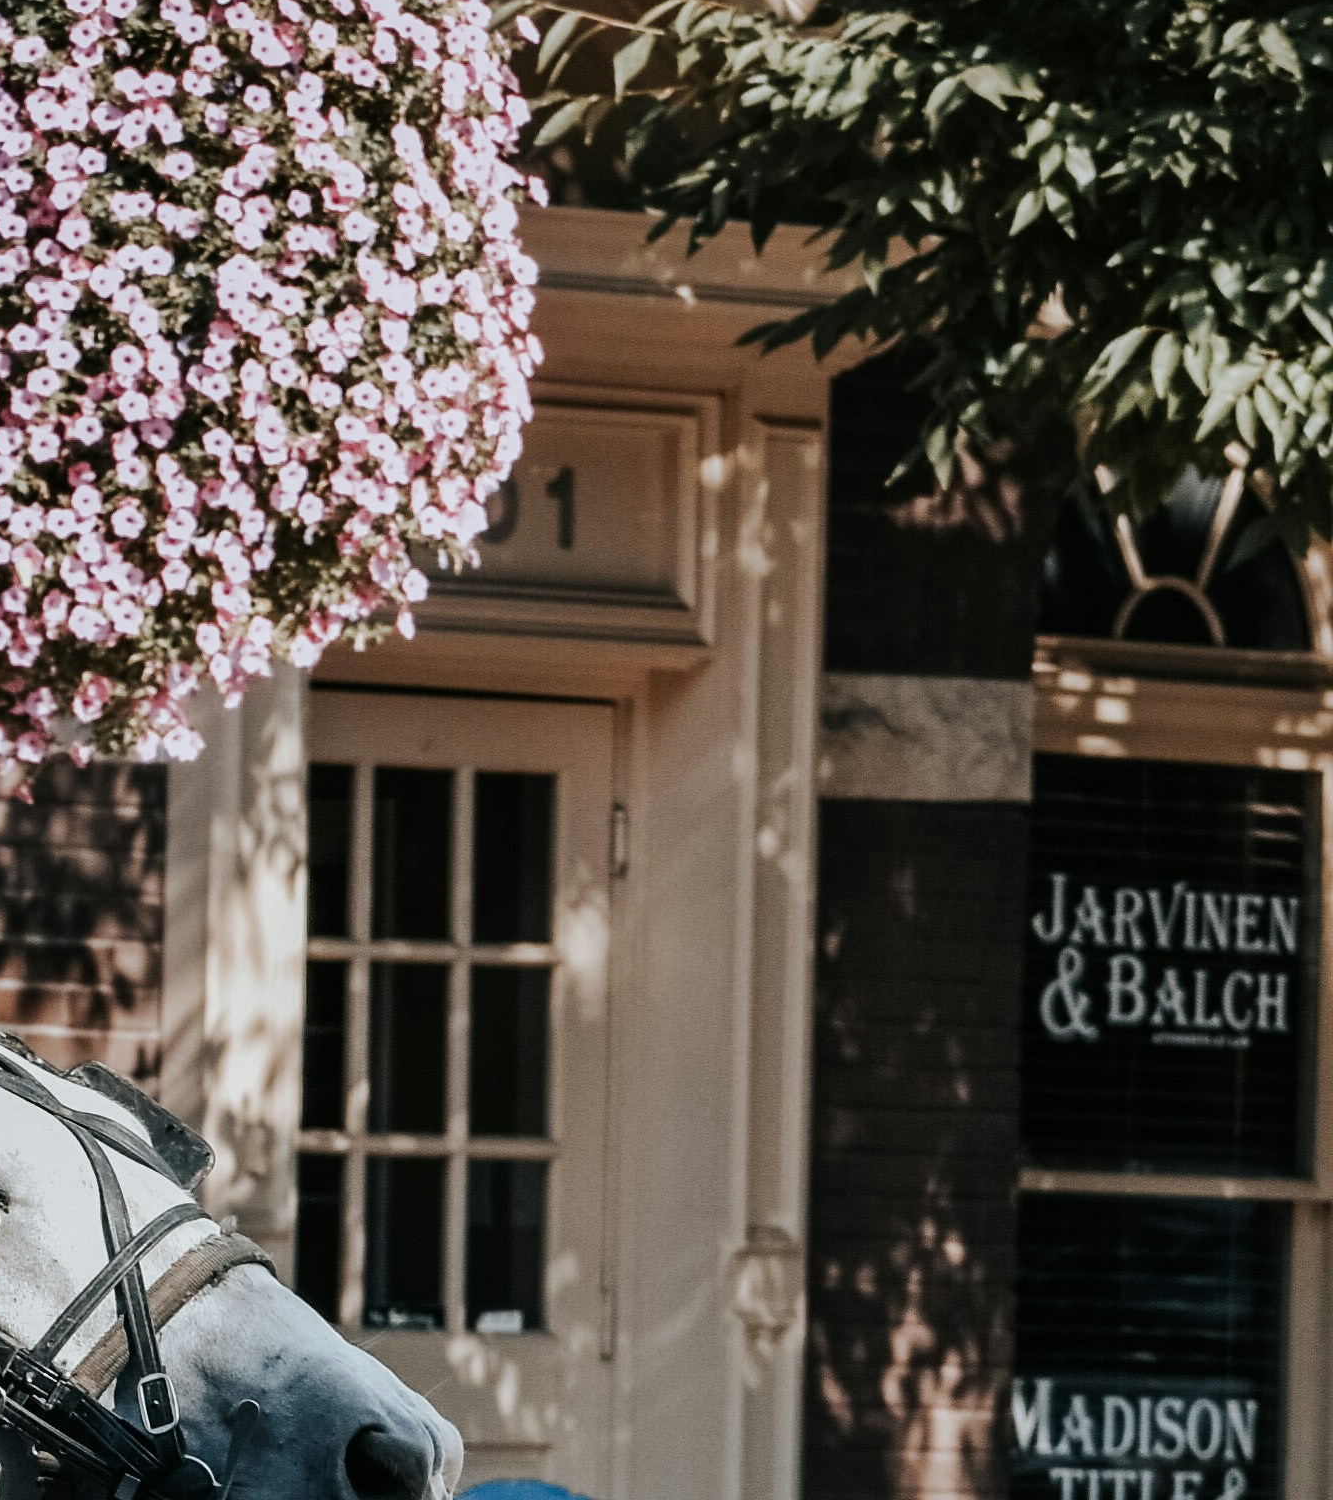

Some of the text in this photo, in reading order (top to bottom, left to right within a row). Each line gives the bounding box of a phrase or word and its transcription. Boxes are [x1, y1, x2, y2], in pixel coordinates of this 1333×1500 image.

[1032, 872, 1299, 954] JARVINEN
[1038, 946, 1288, 1043] & BALCH
[1011, 1377, 1259, 1461] MADISON
